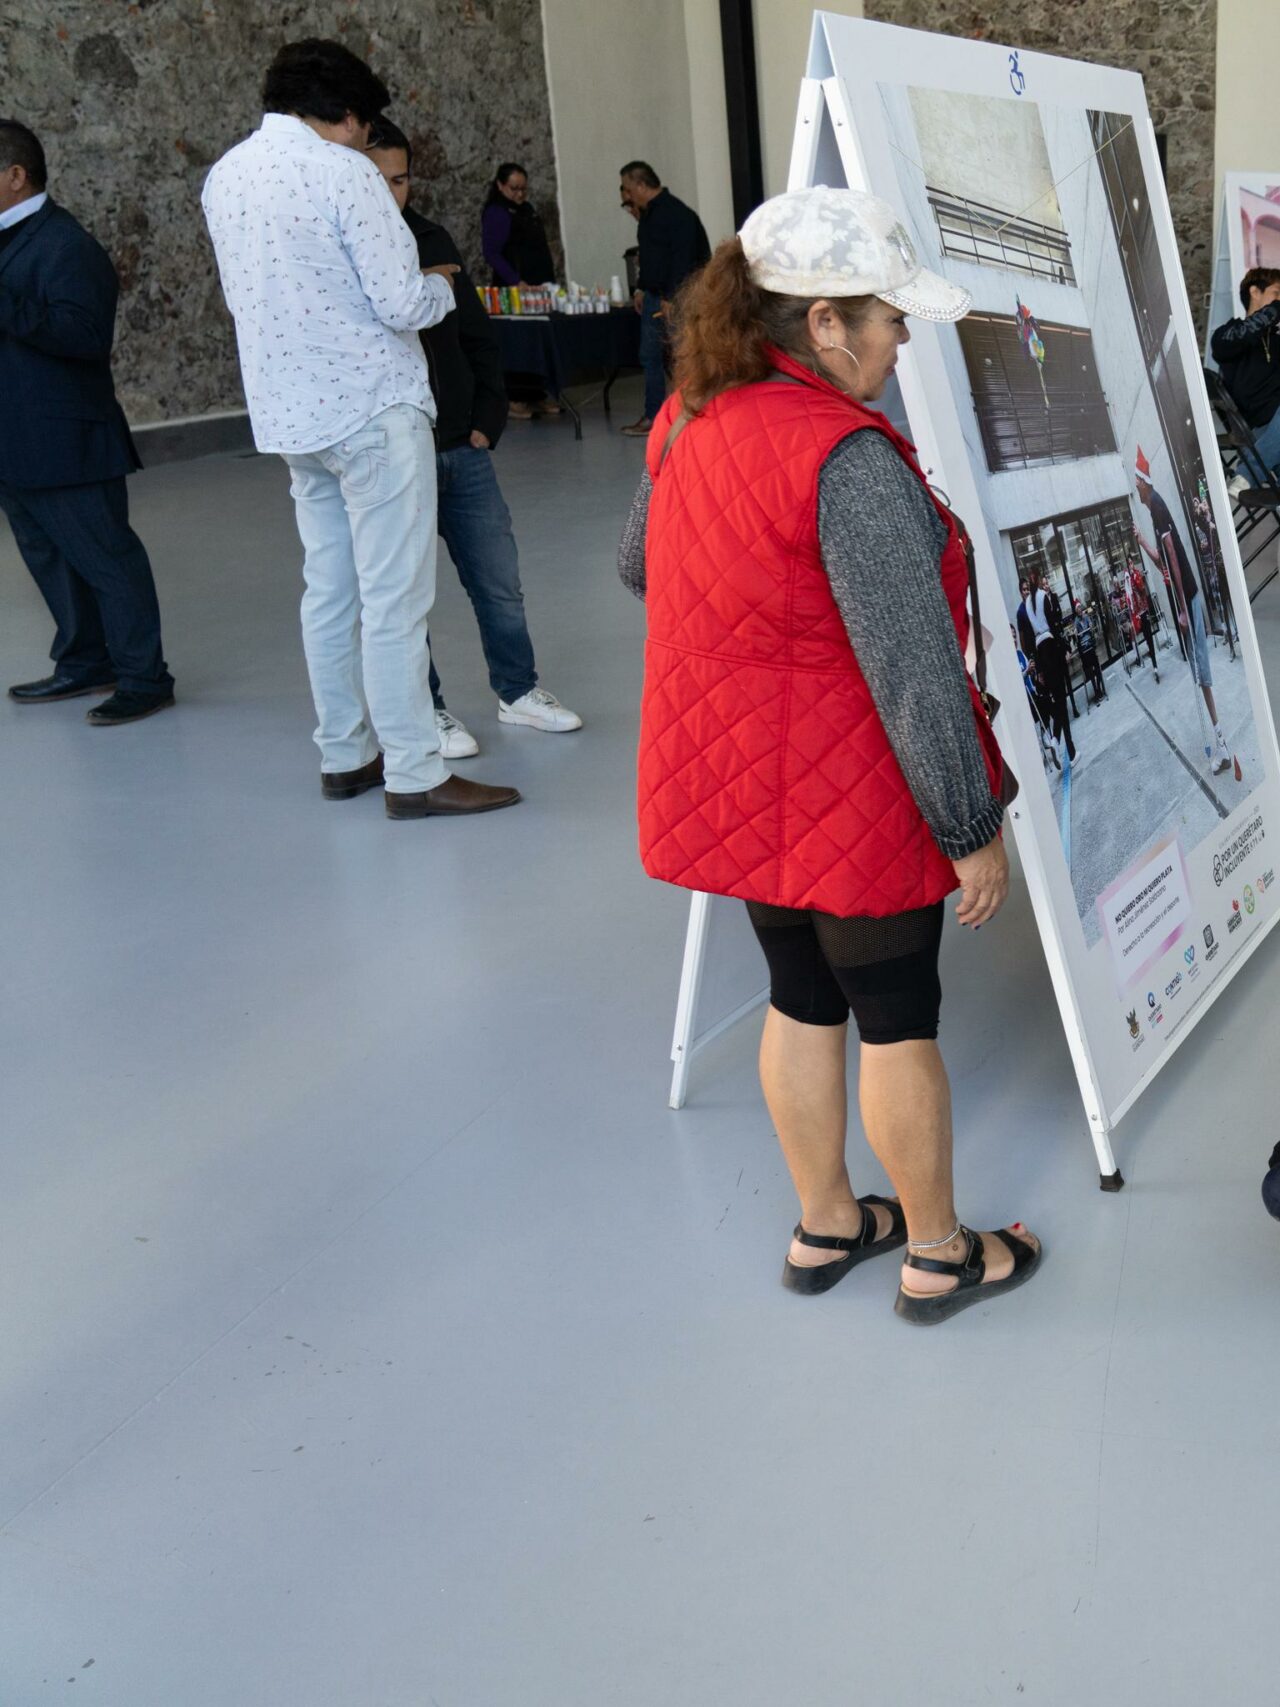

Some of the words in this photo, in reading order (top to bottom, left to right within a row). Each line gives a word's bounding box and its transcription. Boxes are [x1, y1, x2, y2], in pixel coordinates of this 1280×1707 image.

[1221, 848, 1232, 865] POR
[1238, 816, 1262, 847] QUERÉTARO
[1225, 844, 1250, 877] INCLUYENTE
